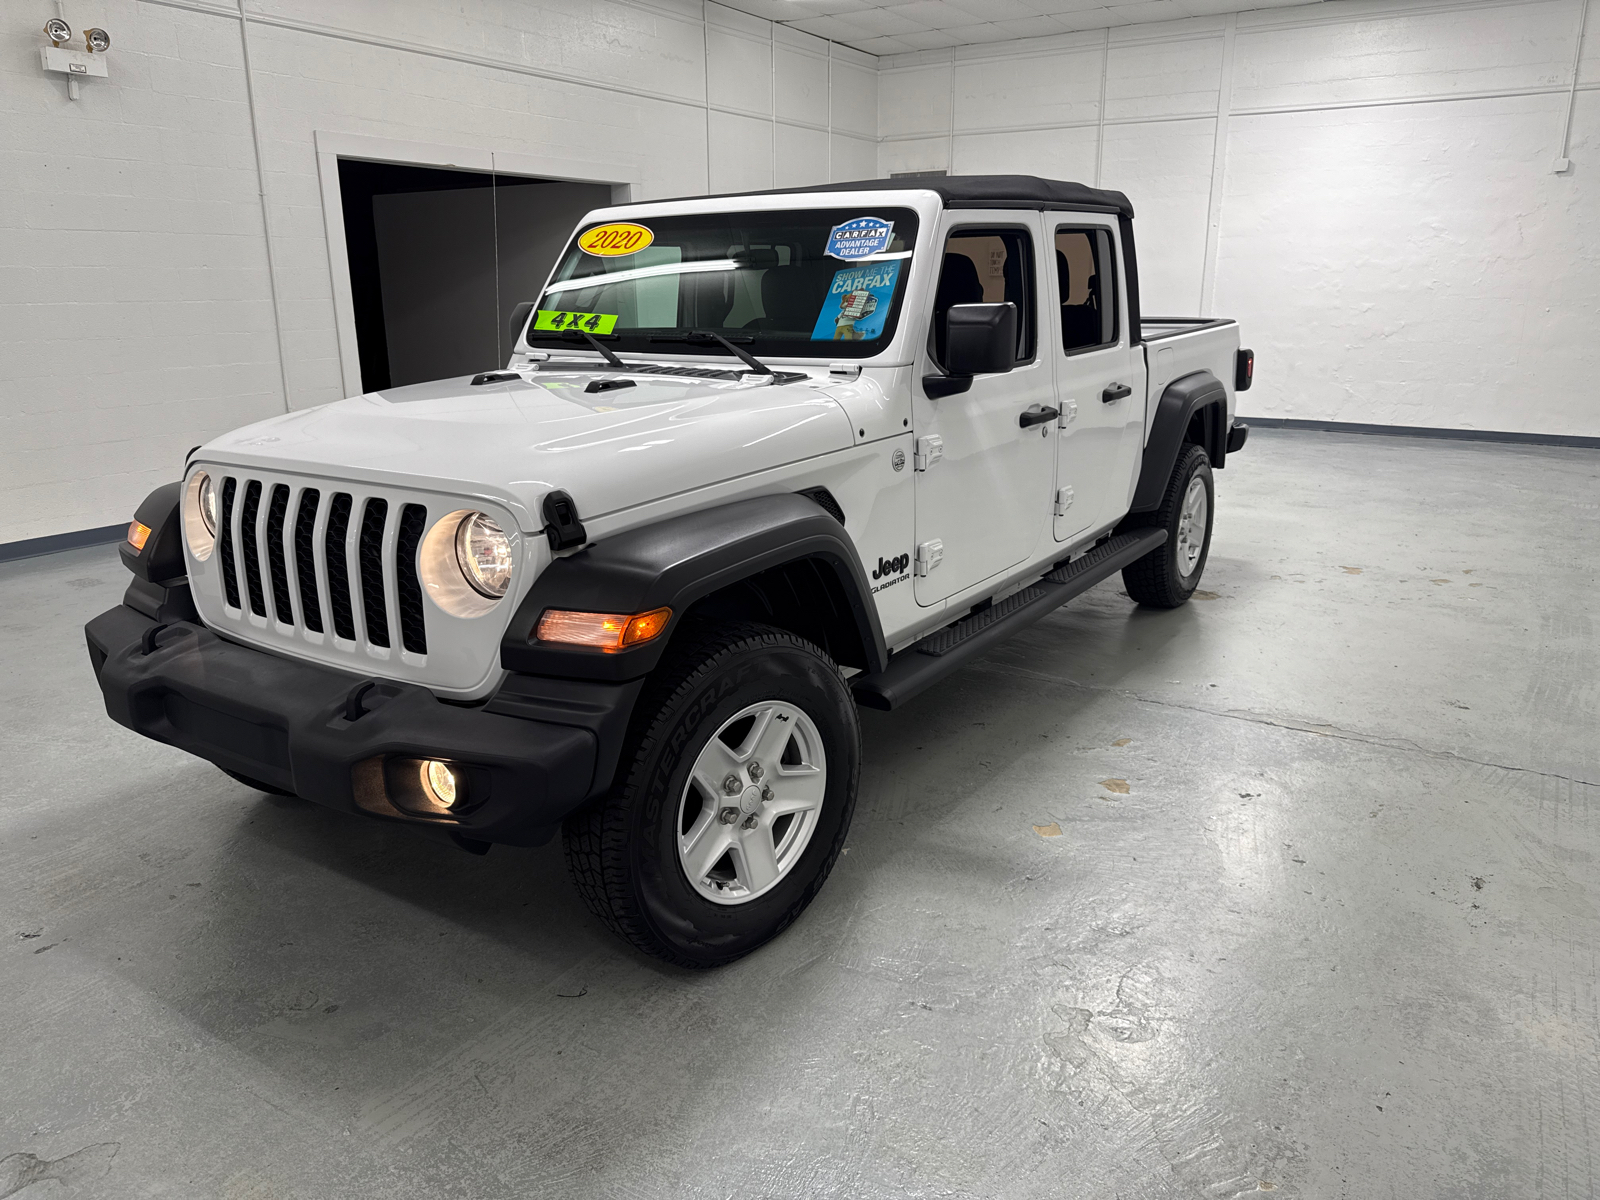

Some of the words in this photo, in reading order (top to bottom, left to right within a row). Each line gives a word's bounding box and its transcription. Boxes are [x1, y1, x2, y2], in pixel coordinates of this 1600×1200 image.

[587, 230, 643, 249] 2020
[835, 228, 886, 239] CARFAX
[835, 239, 879, 248] ADVANTAGE
[840, 248, 870, 256] DEALER
[836, 270, 864, 282] SHOW
[865, 267, 879, 277] ME
[880, 264, 897, 275] THE
[832, 273, 893, 294] CARFAX
[872, 553, 909, 580] Jeep
[871, 573, 910, 594] GLADIATOR
